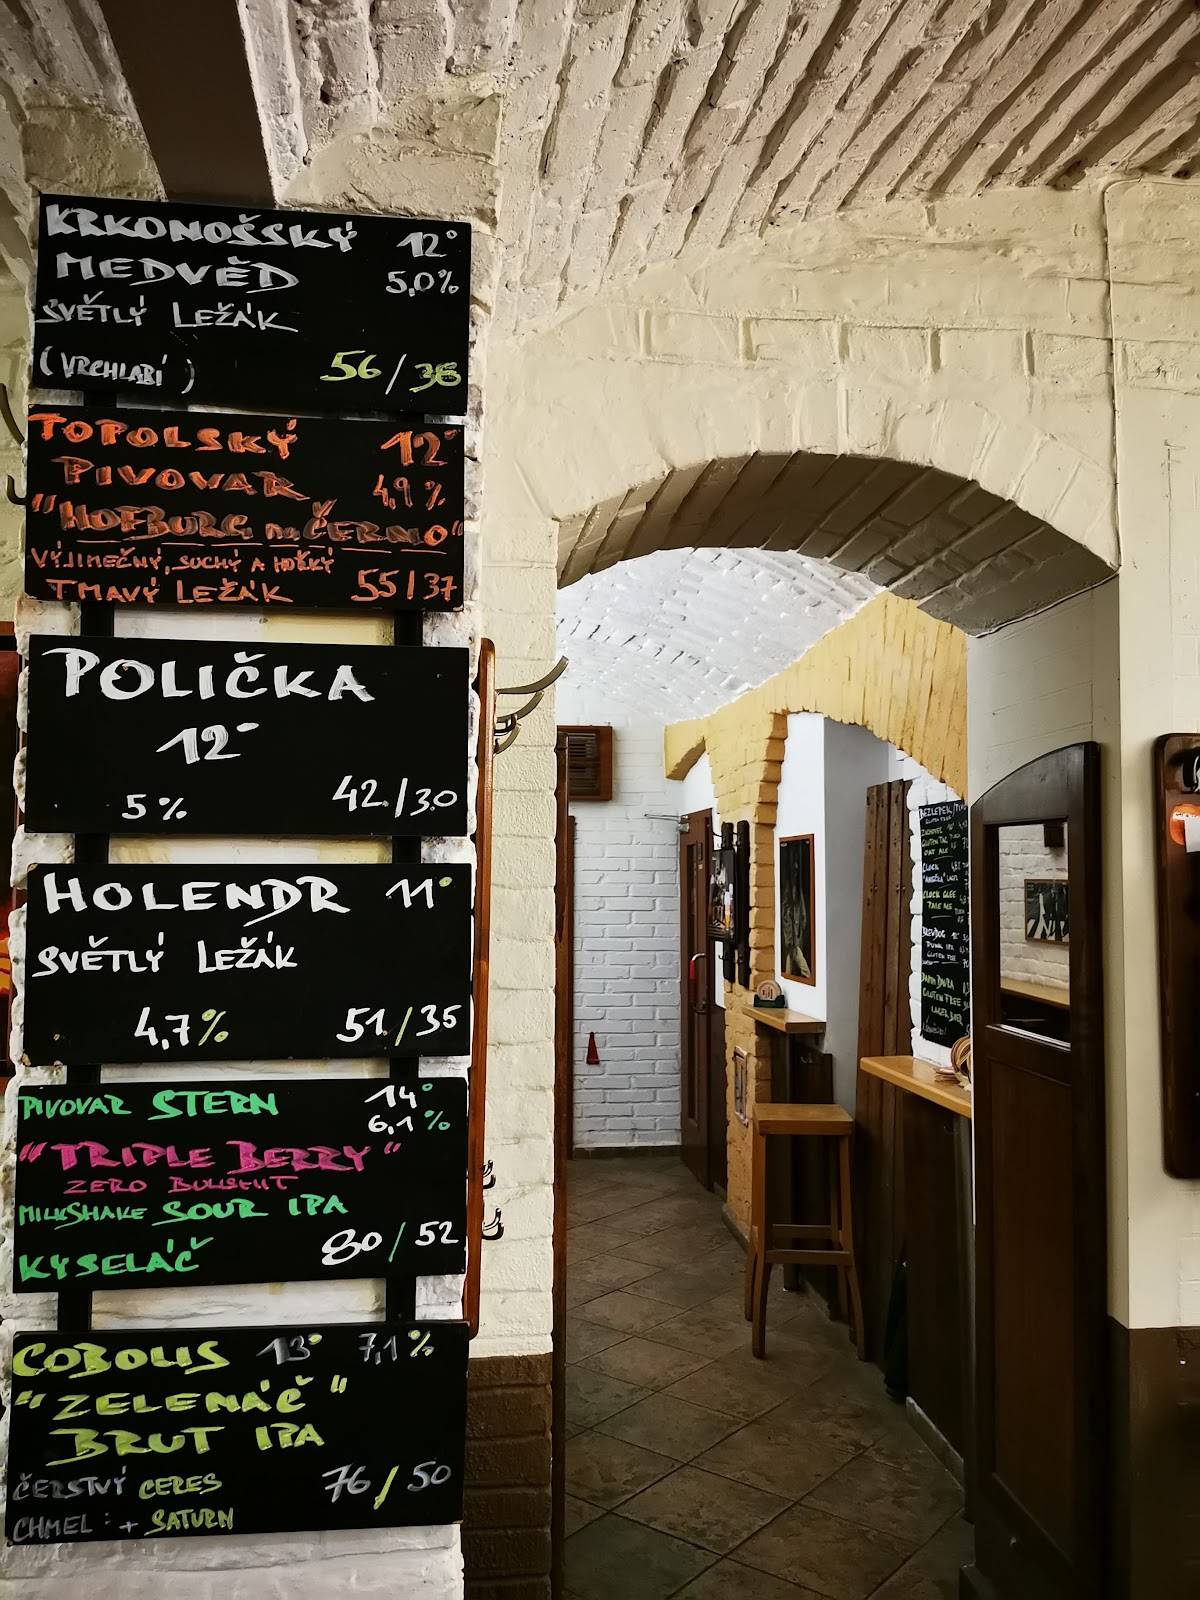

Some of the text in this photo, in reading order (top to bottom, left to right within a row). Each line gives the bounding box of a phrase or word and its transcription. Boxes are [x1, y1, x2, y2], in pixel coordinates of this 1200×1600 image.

[45, 199, 361, 253] KRKONOŠSKÝ
[56, 251, 460, 298] MEDVĚD 5,0%
[33, 290, 299, 333] SVĚTLÝ LEŽÁK
[27, 414, 302, 463] TOPOLSKÝ
[50, 455, 311, 500] PIVOVAR
[171, 548, 242, 573] SUCHÝ
[250, 557, 266, 573] A
[43, 576, 160, 604] TMAVÝ
[176, 577, 294, 604] LEŽÁK
[41, 647, 376, 703] POLIČKA
[43, 871, 352, 928] HOLENDR
[31, 930, 298, 978] SVĚTLÝ LEŽÁK
[133, 1006, 229, 1051] 4,7%
[17, 1094, 133, 1121] PIVOVAR
[147, 1089, 280, 1121] STERN
[63, 1177, 148, 1194] ZERO
[151, 1197, 269, 1227] SOUR
[288, 1193, 349, 1217] IPA
[18, 1236, 215, 1282] KYSELÁČ
[45, 1422, 325, 1467] BRUT IPA
[13, 1463, 127, 1499] ČERSTVÝ
[138, 1472, 223, 1500] CERES
[143, 1507, 237, 1539] SATURN
